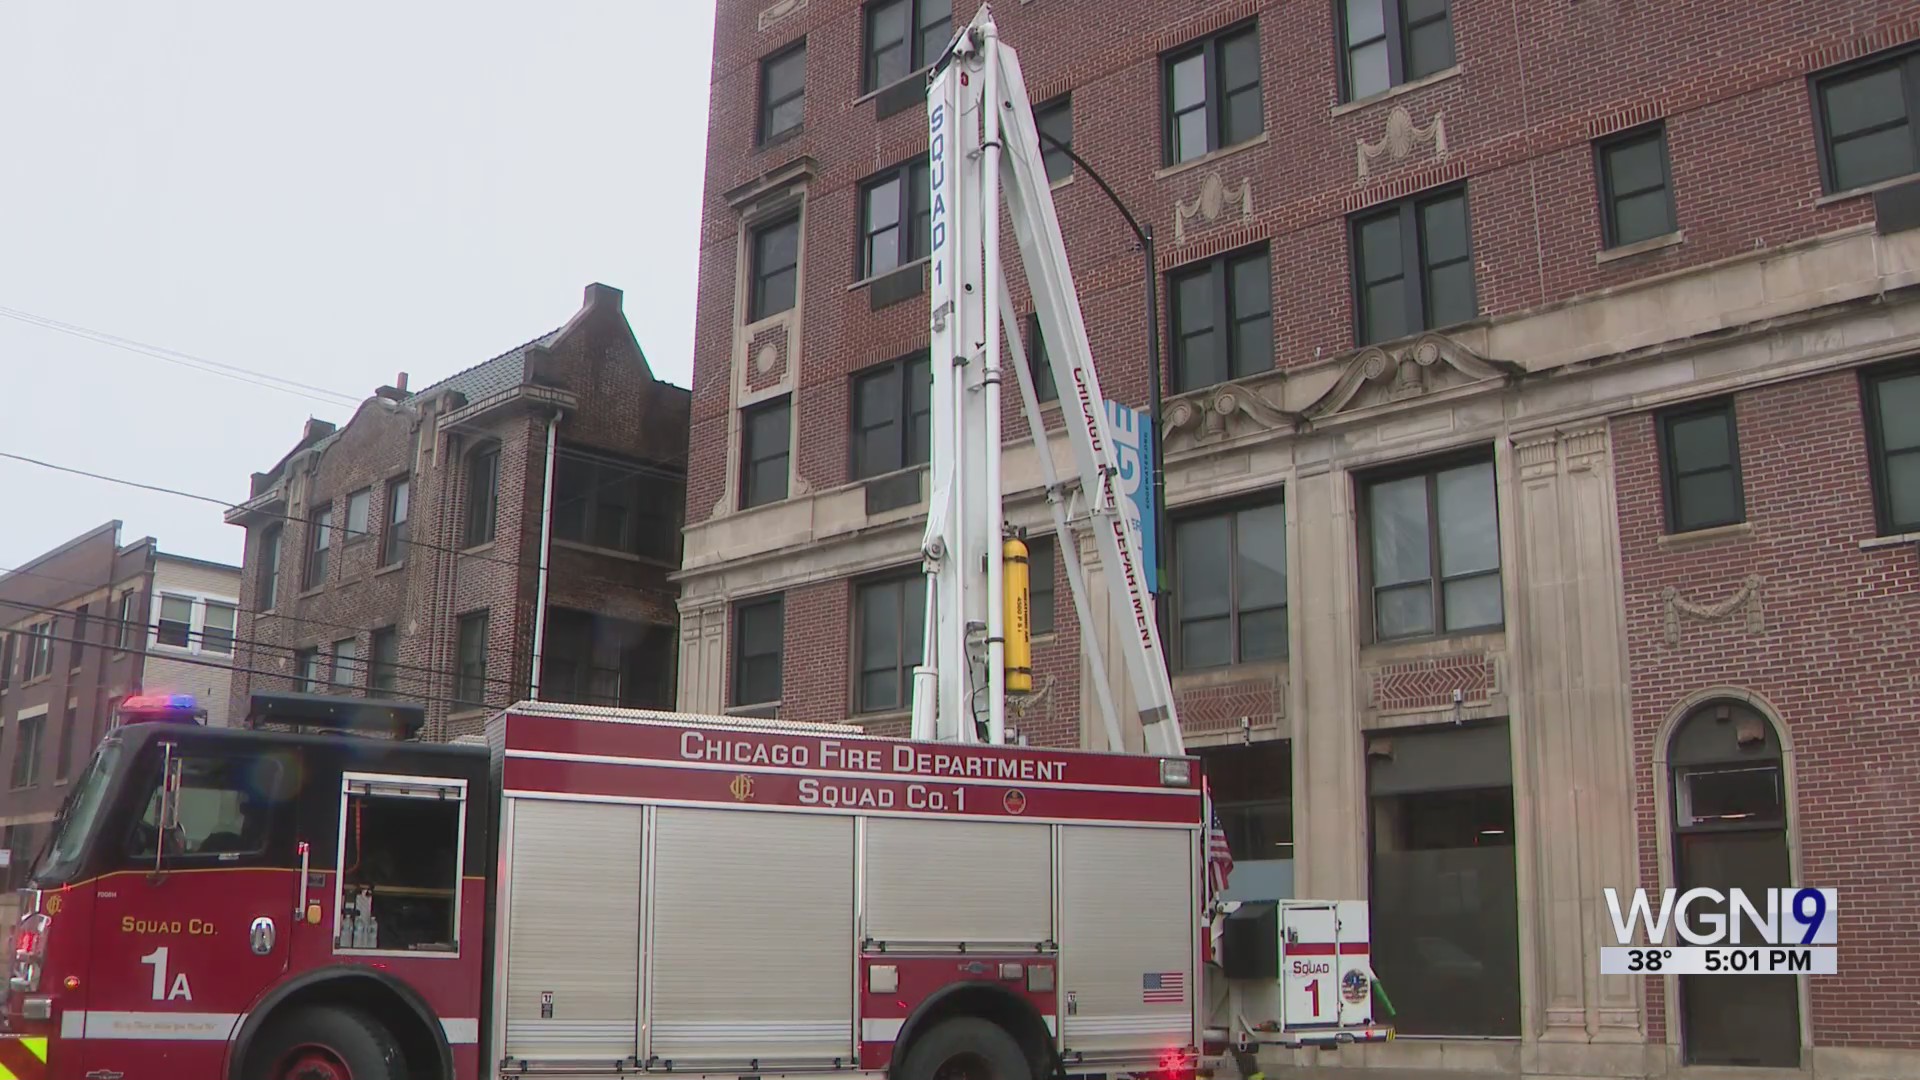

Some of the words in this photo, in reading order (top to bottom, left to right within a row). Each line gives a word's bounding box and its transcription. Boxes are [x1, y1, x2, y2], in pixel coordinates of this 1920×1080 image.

[930, 104, 946, 251] SQUAD
[934, 259, 943, 286] 1
[680, 731, 809, 767] CHICAGO
[819, 740, 882, 771] FIRE
[892, 744, 1068, 781] DEPARTMENT
[798, 778, 894, 808] SQUAD
[121, 915, 182, 934] SQUAD
[188, 918, 219, 936] CO.
[1292, 960, 1330, 975] SQUAD
[1304, 978, 1320, 1017] 1
